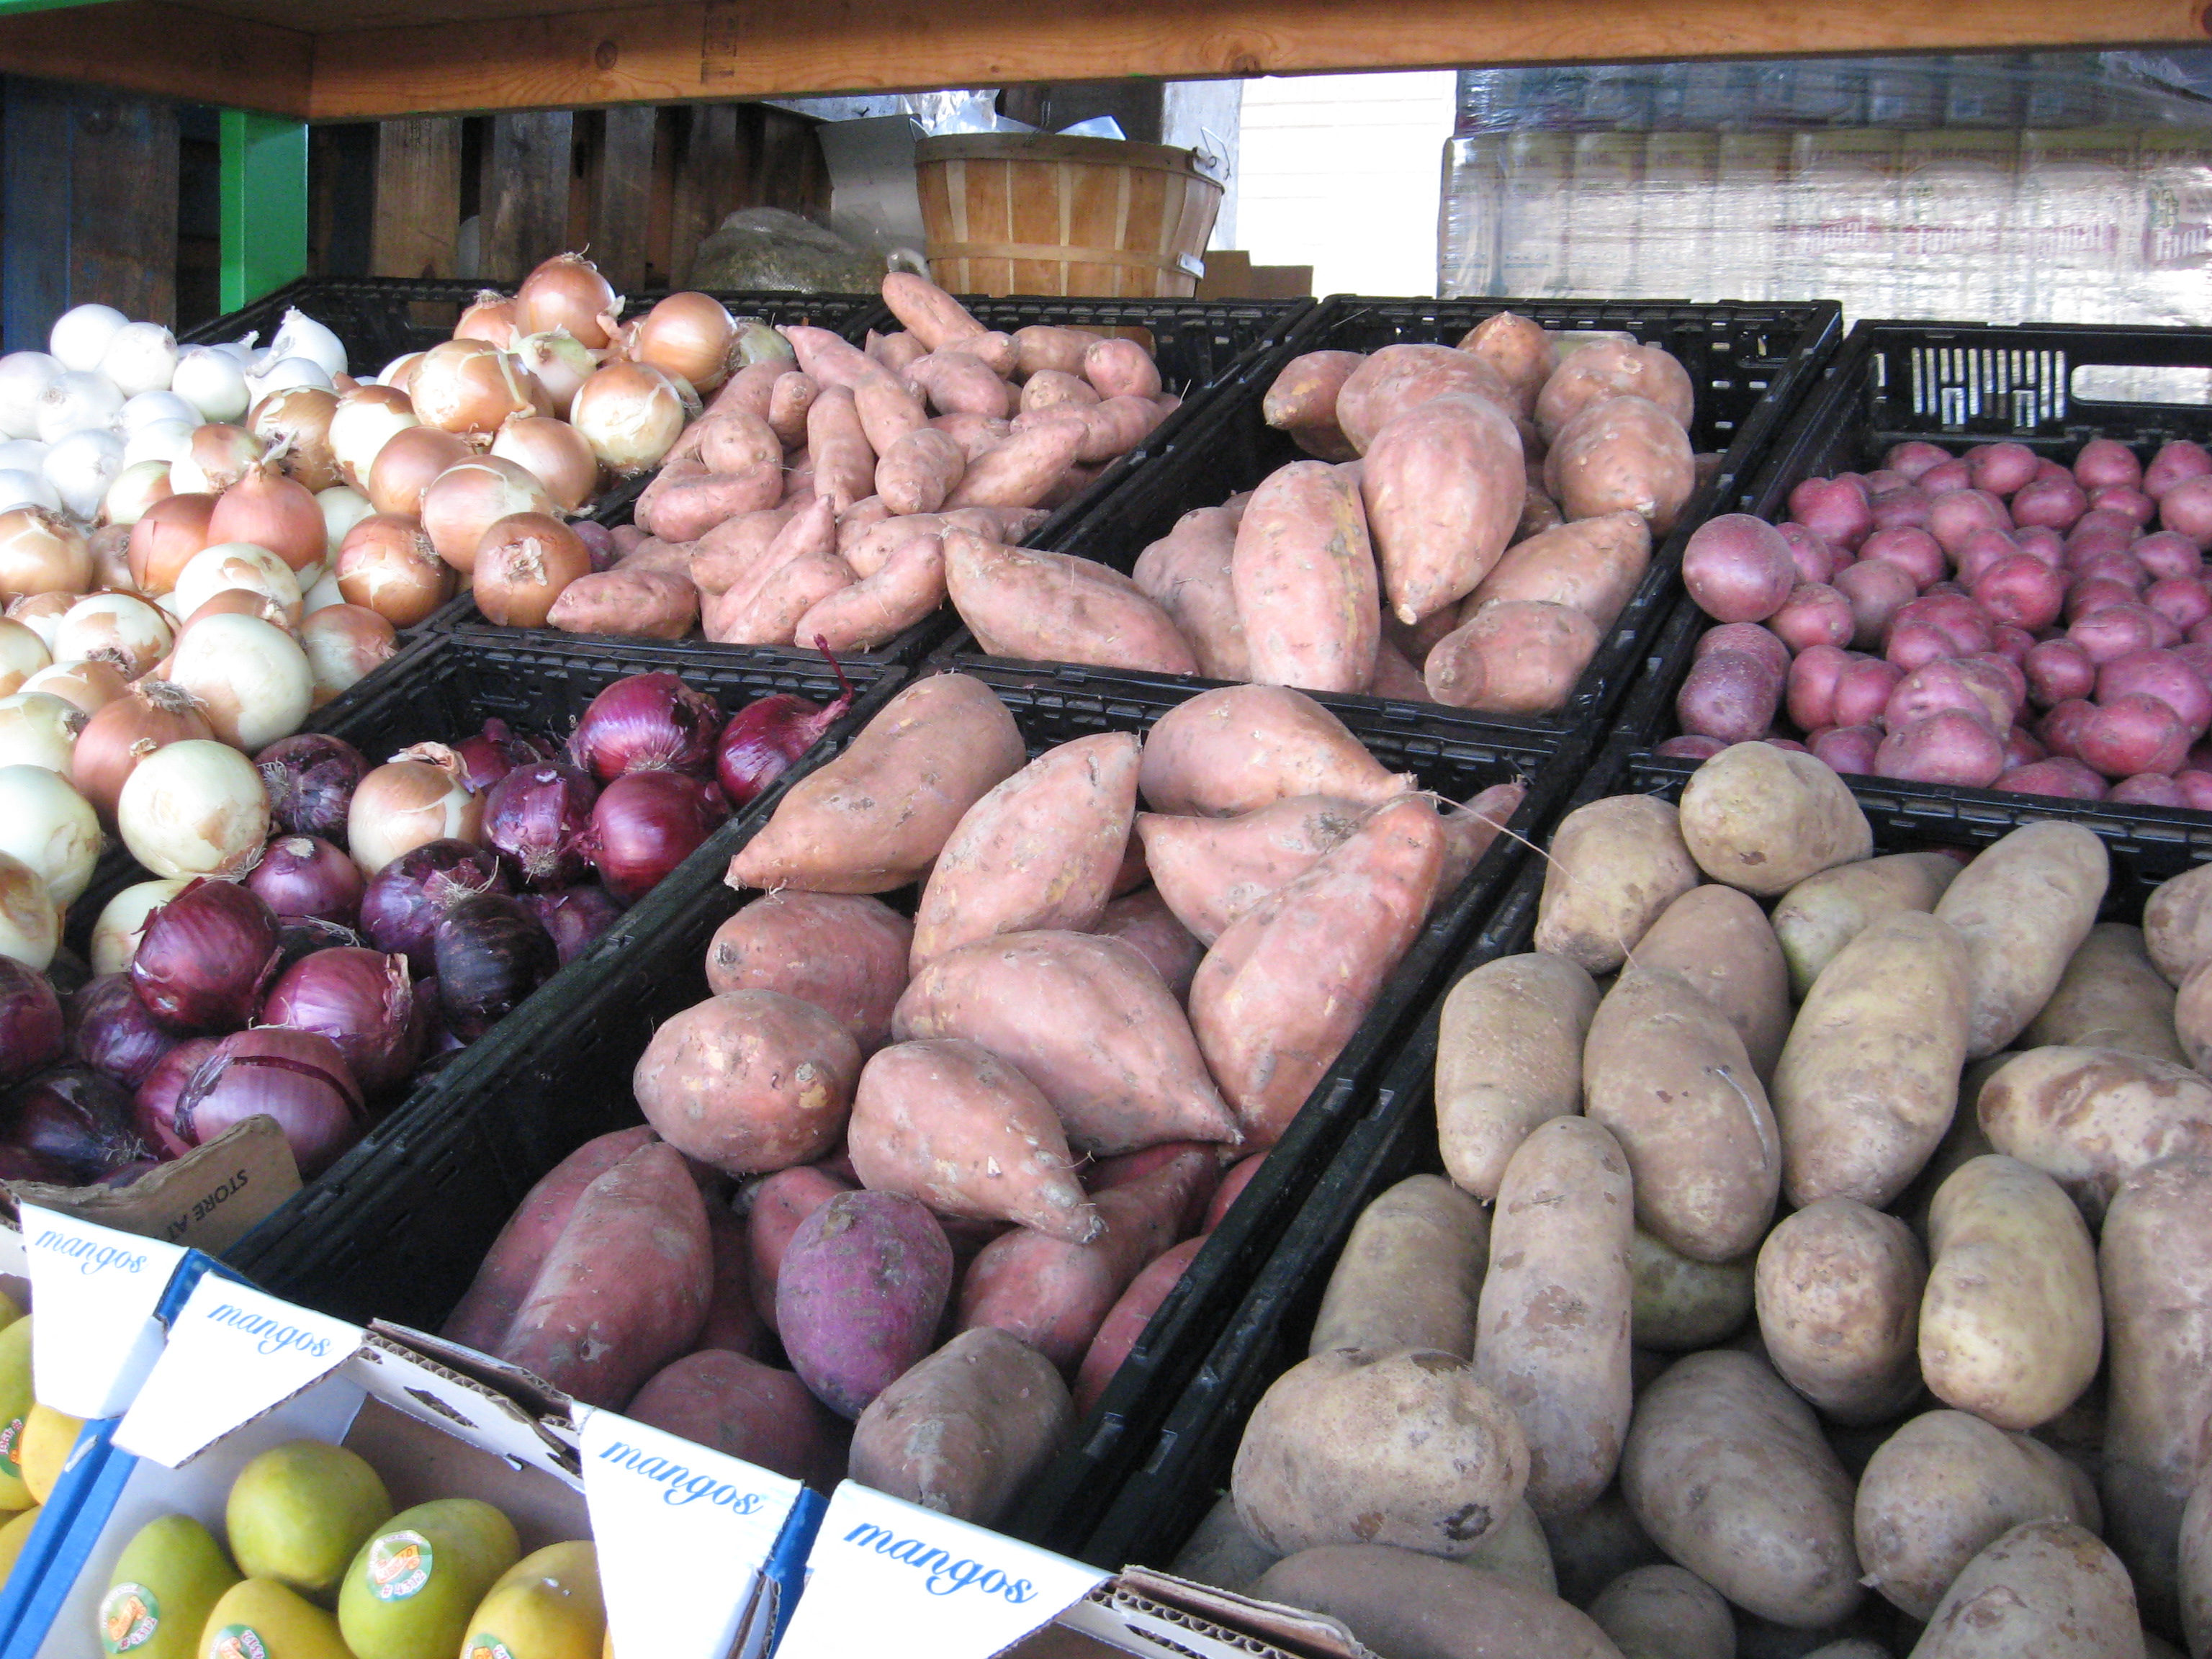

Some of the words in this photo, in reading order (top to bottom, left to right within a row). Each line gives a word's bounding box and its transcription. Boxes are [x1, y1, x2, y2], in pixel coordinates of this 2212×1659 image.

[192, 1169, 248, 1222] STORE
[35, 1229, 149, 1275] mangos
[207, 1301, 335, 1357] mangos
[599, 1440, 764, 1516] mangos
[843, 1519, 1038, 1604] mangos
